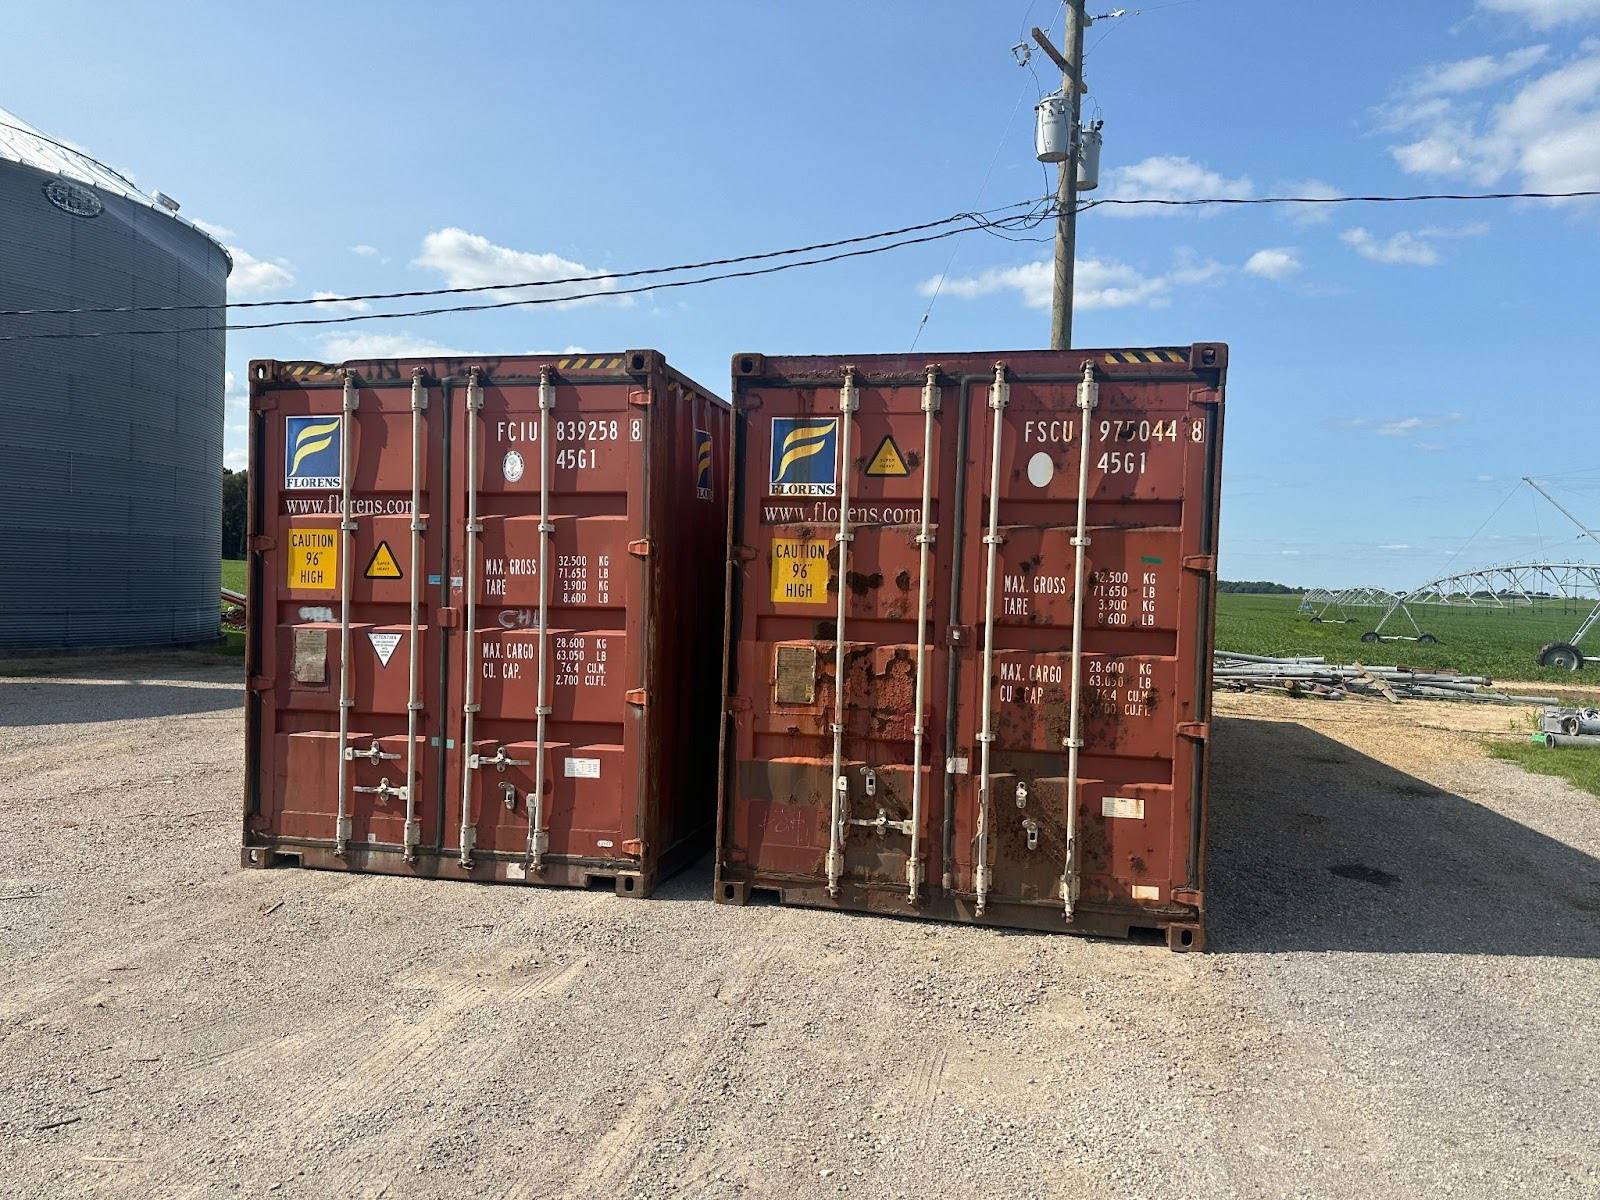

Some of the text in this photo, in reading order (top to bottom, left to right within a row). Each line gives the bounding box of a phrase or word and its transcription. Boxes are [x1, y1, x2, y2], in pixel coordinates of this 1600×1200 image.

[497, 420, 641, 442] FCIU 839258 8
[1024, 420, 1202, 443] FSCU 975044 8
[556, 449, 596, 469] 45G1
[1097, 452, 1146, 474] 45G1
[286, 478, 340, 488] FLORENS
[771, 484, 835, 495] FLORENS
[764, 502, 922, 523] www.floens.com
[292, 534, 334, 548] CAUTION
[776, 544, 825, 559] CAUTION
[485, 558, 537, 575] MAX. GROSS
[558, 556, 609, 567] 32.500 KG
[300, 570, 323, 584] HIGH
[558, 568, 609, 579] 71.650 LB
[1143, 572, 1156, 584] KG
[485, 579, 507, 595] TARE
[563, 580, 609, 591] 3.900 KG
[786, 584, 813, 598] HIGH
[1004, 575, 1066, 594] MAX. GROSS
[1093, 585, 1156, 598] 71.650 LB
[563, 592, 609, 604] 8.600 LB
[1004, 597, 1028, 615] TARE
[1098, 599, 1155, 612] 3.900 KG
[1098, 612, 1154, 626] 8600 LB
[556, 637, 607, 649] 28.600 KG
[482, 642, 534, 659] MAX. CARGO
[556, 650, 607, 662] 63.050 LB
[483, 663, 521, 679] CU. CAP.
[561, 662, 606, 674] 76.4 CU.M.
[1000, 663, 1062, 683] MAX. CARGO
[1089, 661, 1152, 675] 28.600 KG
[555, 675, 606, 686] 2.700 CU.FT.
[1139, 677, 1151, 689] LB
